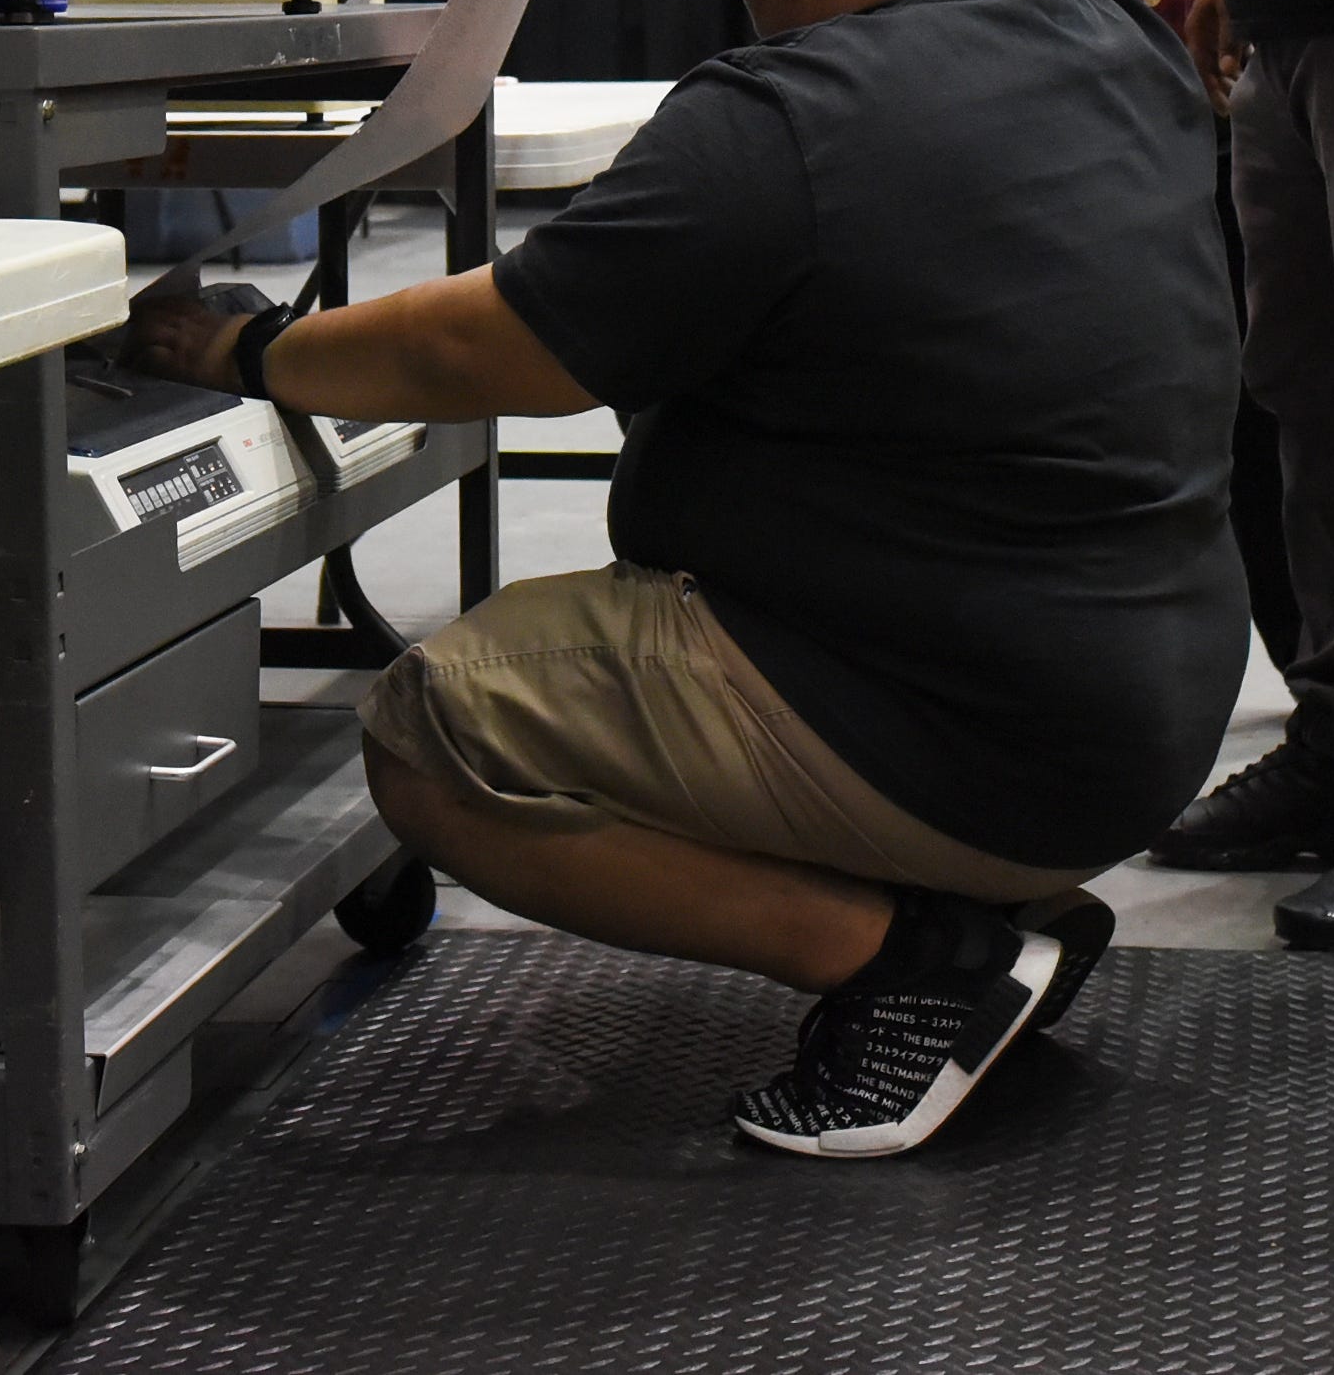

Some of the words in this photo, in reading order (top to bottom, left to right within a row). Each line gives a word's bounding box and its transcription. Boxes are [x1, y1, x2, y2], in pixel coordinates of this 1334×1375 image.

[873, 1008, 916, 1024] BANDES
[903, 1032, 922, 1045] THE
[923, 1036, 954, 1049] BRAN
[856, 1073, 876, 1086] THE
[878, 1080, 915, 1100] BRAND
[881, 1098, 902, 1112] MIT
